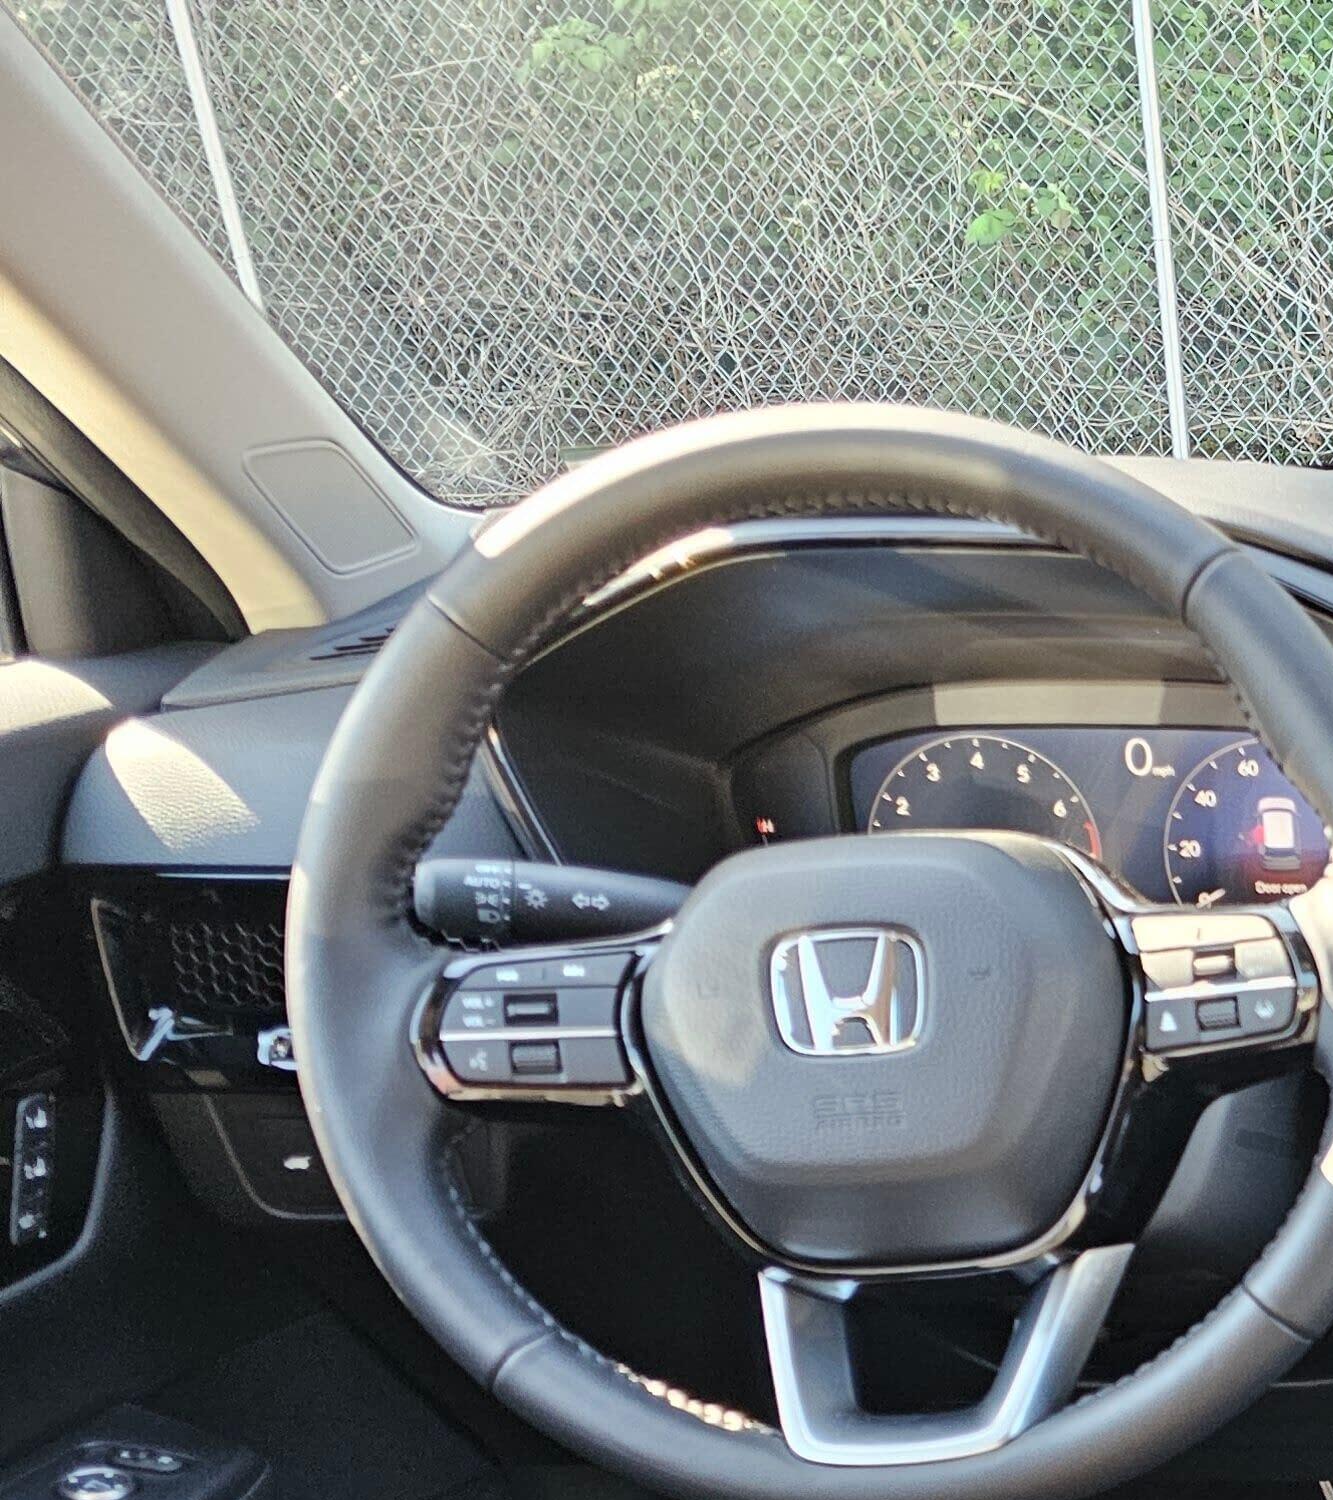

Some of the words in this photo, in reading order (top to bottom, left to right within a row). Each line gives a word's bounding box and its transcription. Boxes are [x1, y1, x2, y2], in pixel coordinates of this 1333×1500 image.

[970, 751, 985, 770] 4
[1124, 737, 1153, 777] 0
[926, 762, 941, 782] 3
[1016, 763, 1032, 784] 5
[1237, 759, 1260, 777] 60
[895, 796, 911, 816] 2
[1194, 789, 1217, 808] 40
[1053, 799, 1067, 818] 6
[1178, 839, 1201, 858] 20
